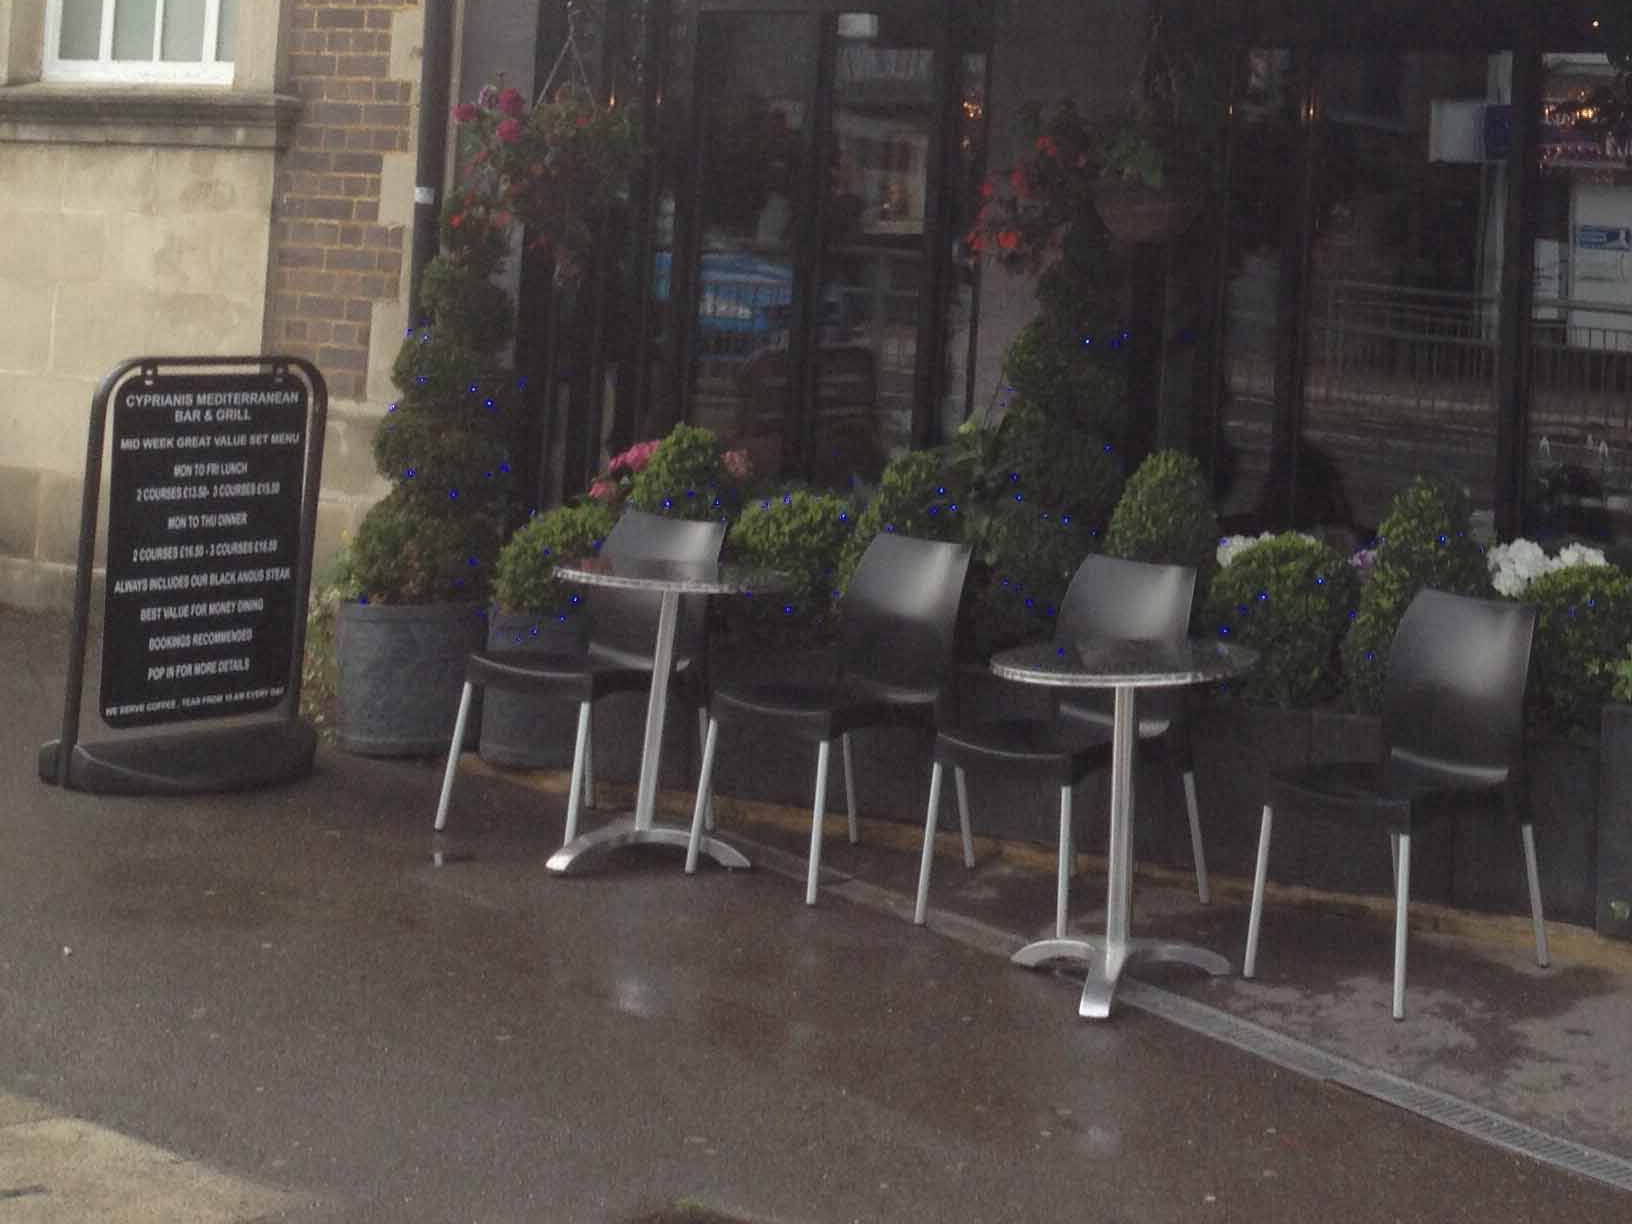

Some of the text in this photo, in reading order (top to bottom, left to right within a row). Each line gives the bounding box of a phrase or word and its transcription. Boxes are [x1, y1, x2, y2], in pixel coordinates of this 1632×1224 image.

[126, 392, 299, 408] CYPRIANIS MEDITERRANEAN
[175, 410, 200, 423] BAR
[216, 409, 251, 421] GRILL
[121, 438, 140, 450] MID
[143, 437, 173, 449] WEEK
[177, 435, 210, 448] GREAT
[214, 434, 246, 447] VALUE
[271, 433, 299, 444] MENU
[194, 463, 205, 475] TO
[221, 462, 247, 474] LUNCH
[189, 515, 199, 528] TO
[210, 571, 236, 586] BLACK
[191, 603, 207, 617] FOR
[176, 664, 192, 678] FOR
